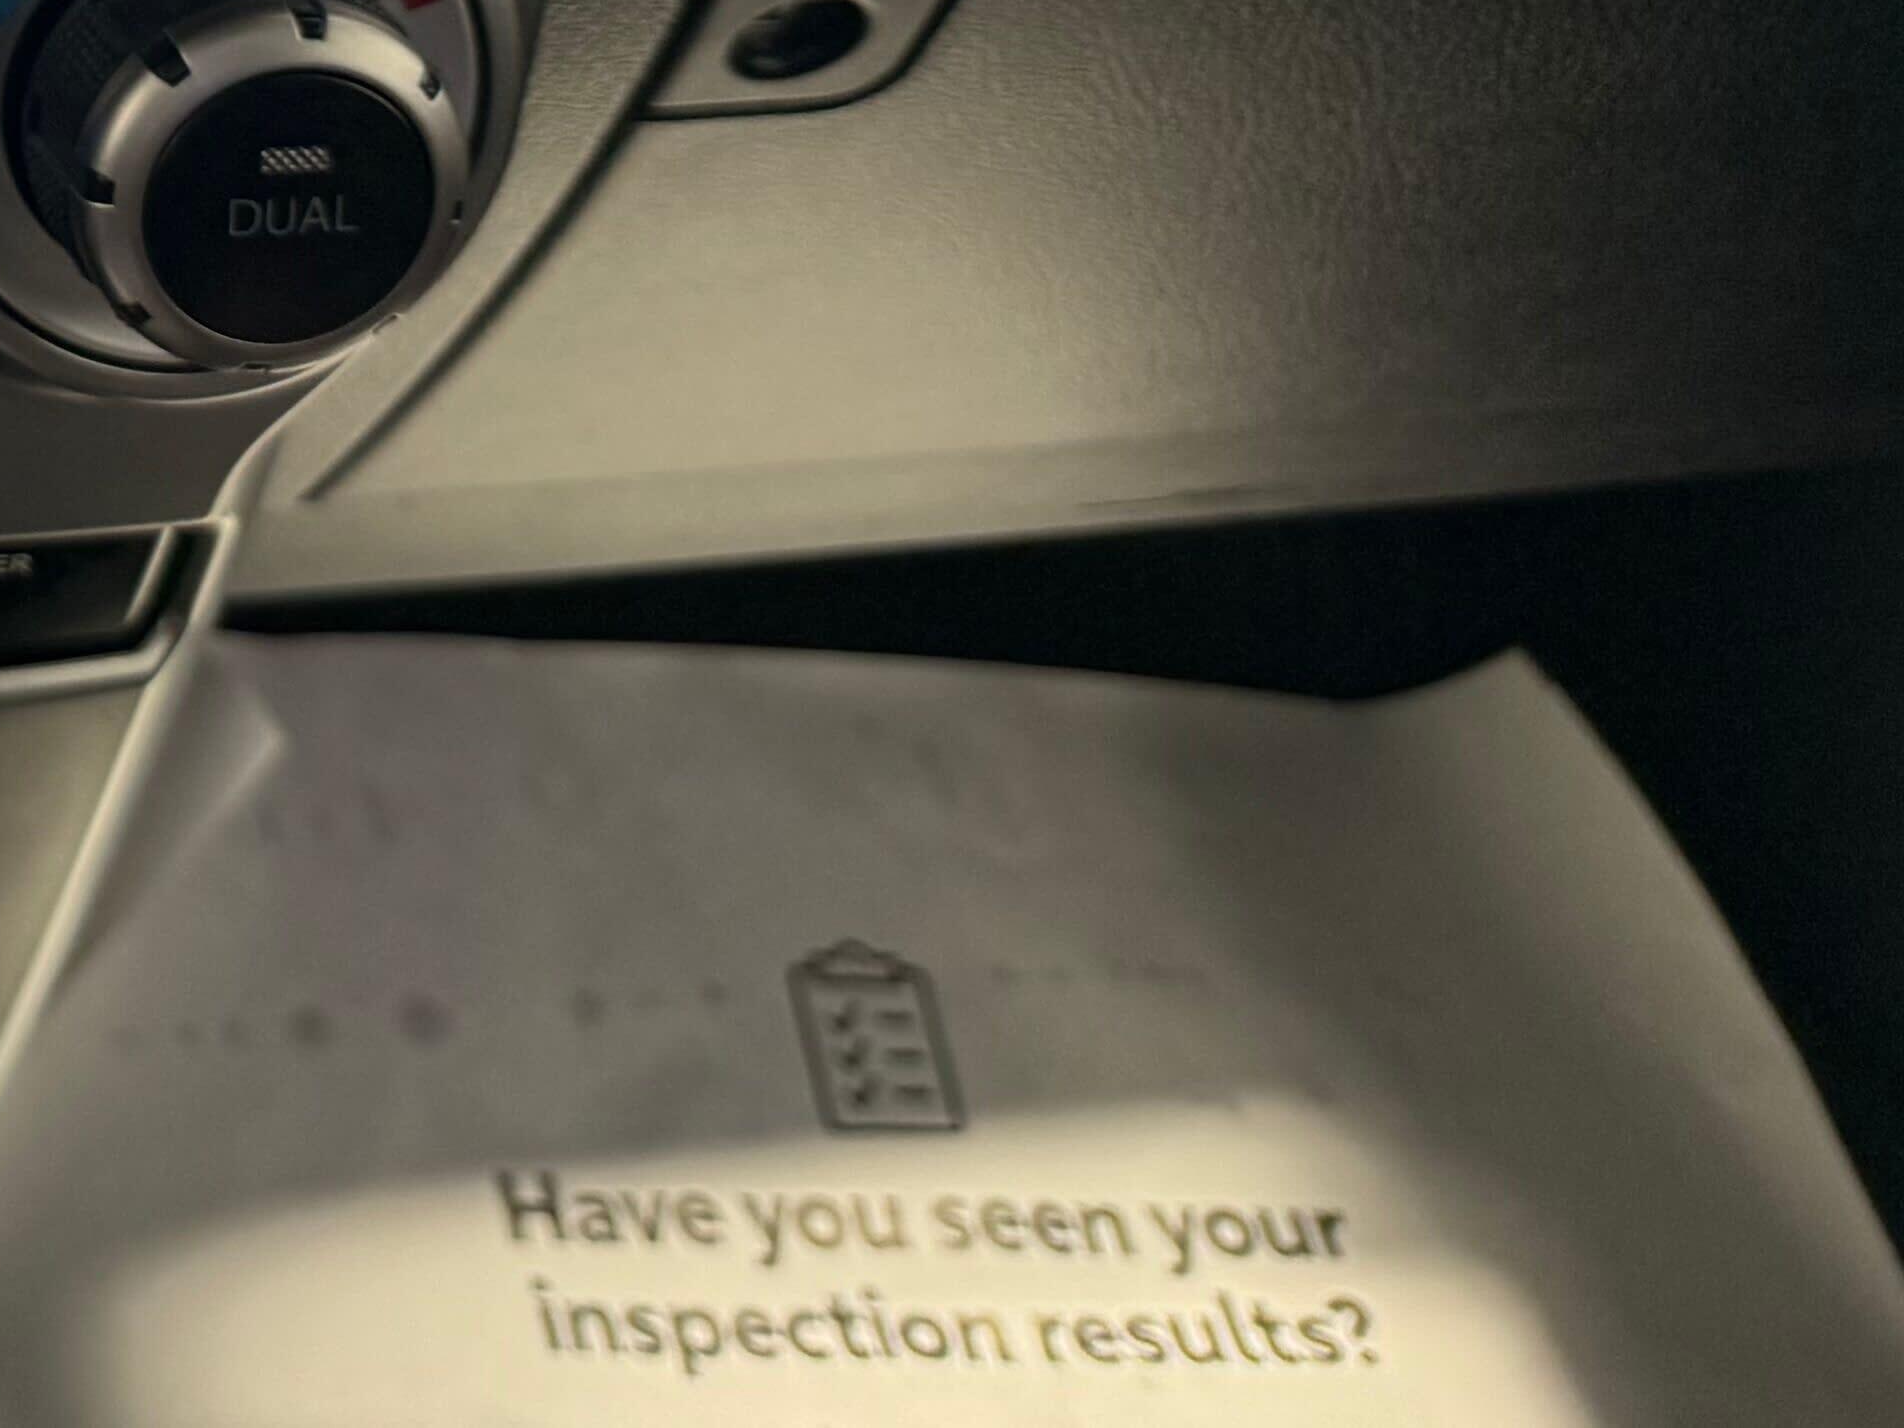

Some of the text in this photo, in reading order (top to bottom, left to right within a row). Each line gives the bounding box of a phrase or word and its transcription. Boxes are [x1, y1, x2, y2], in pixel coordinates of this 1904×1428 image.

[225, 192, 362, 240] DUAL
[493, 1168, 1349, 1275] Have you seen your
[528, 1275, 1381, 1377] inspection results?
